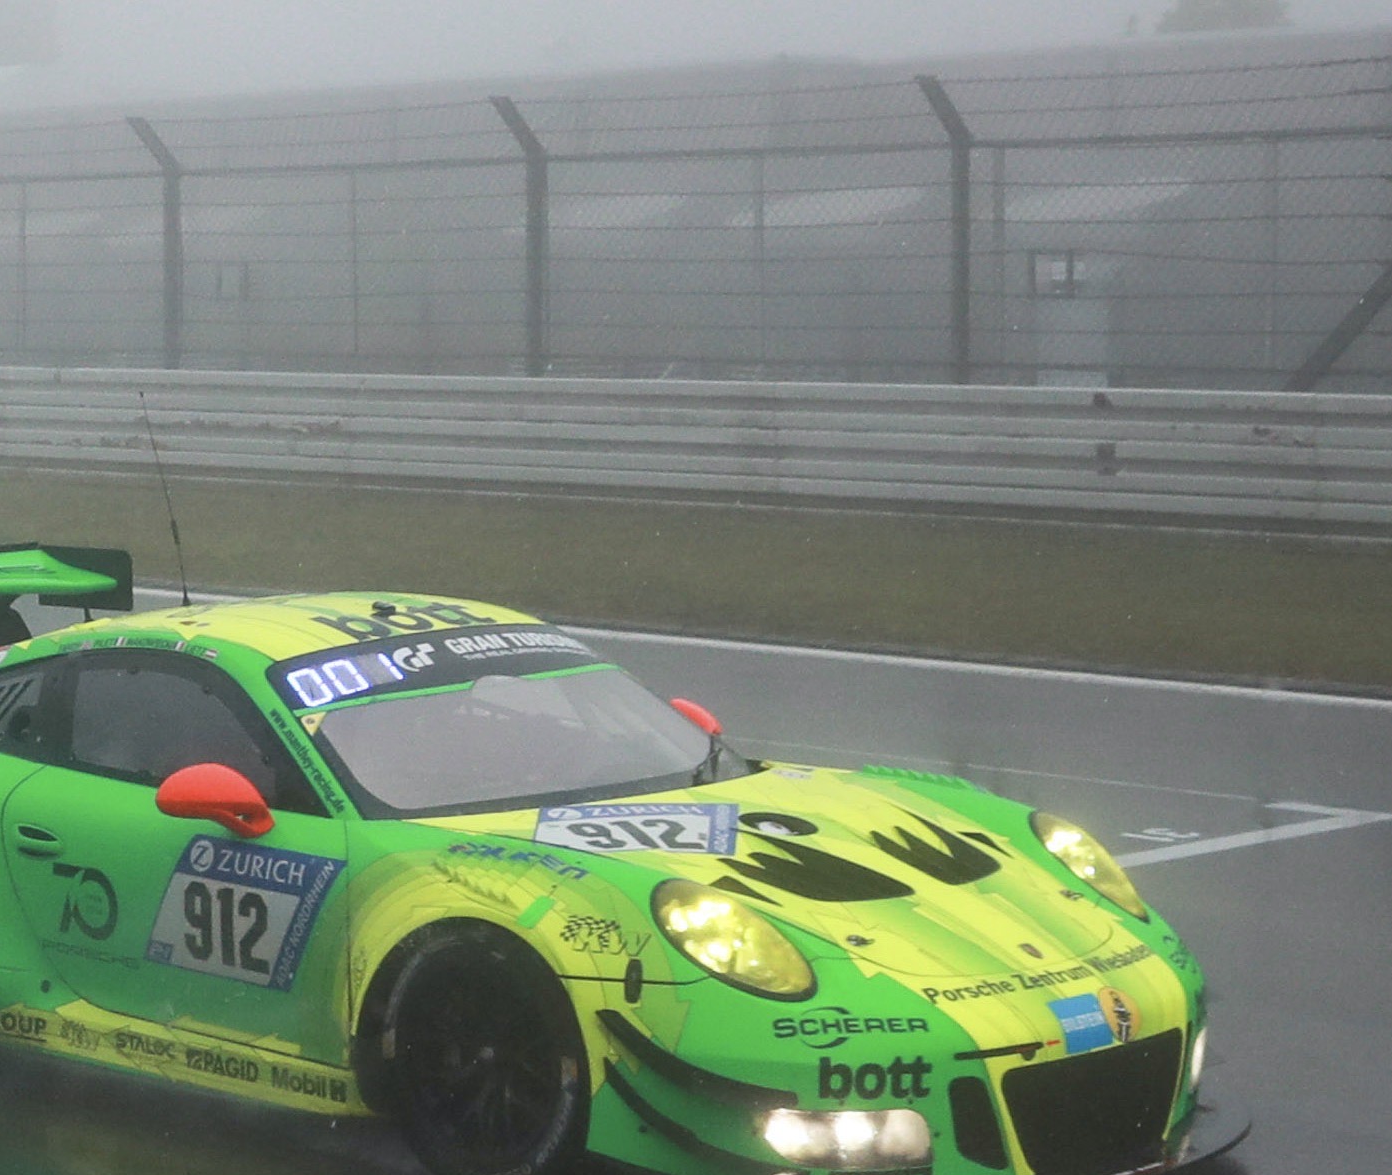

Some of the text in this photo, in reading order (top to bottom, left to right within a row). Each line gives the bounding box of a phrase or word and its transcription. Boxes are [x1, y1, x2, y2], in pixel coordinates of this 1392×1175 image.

[311, 602, 497, 642] bott
[444, 634, 507, 654] GRAN
[567, 818, 706, 850] 912
[218, 849, 305, 886] ZURICH
[184, 881, 270, 975] 912
[923, 977, 1016, 1005] Porsche
[1012, 962, 1096, 990] Zentrum
[773, 1017, 929, 1039] SCHERER
[204, 1051, 260, 1083] PAGID
[271, 1065, 327, 1098] Mobil
[818, 1055, 933, 1100] bott
